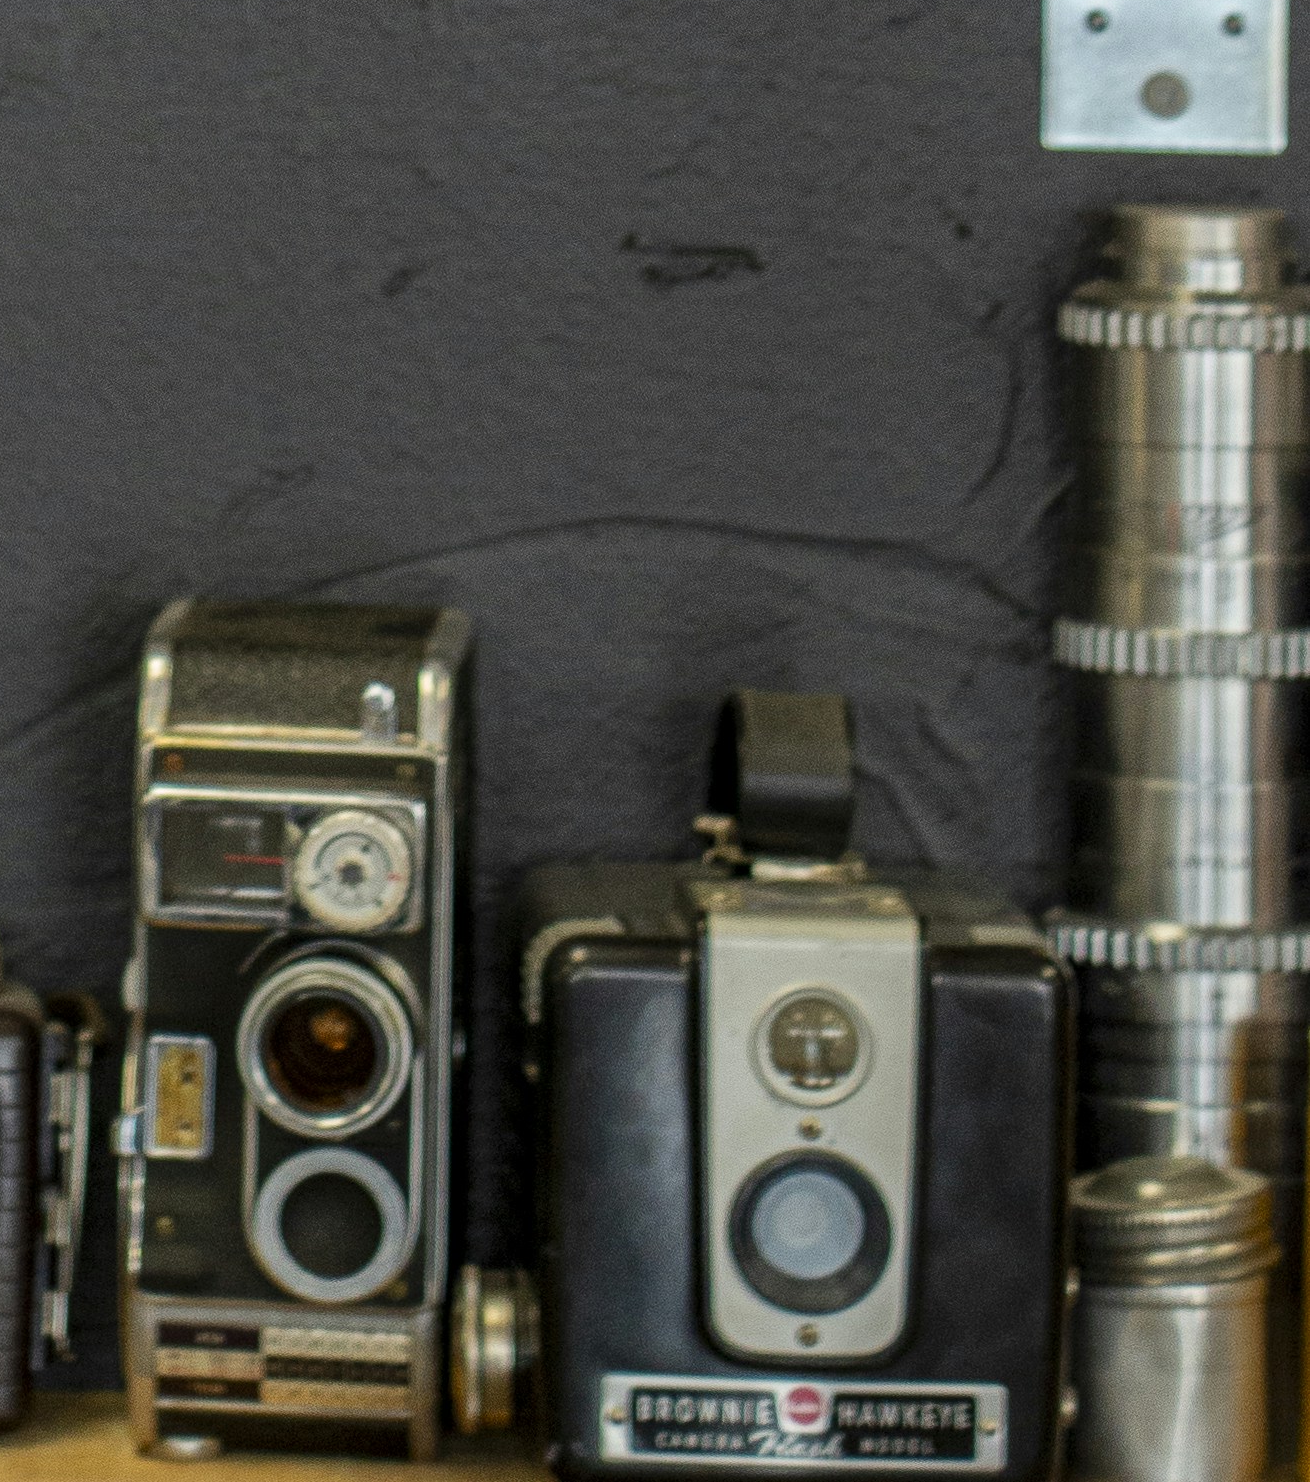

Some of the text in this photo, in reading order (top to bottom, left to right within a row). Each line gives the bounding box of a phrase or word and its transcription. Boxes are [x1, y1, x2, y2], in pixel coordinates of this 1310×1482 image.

[635, 1394, 773, 1425] BROWNIE
[837, 1400, 972, 1430] HAWKEYE
[654, 1431, 743, 1450] CAMERA
